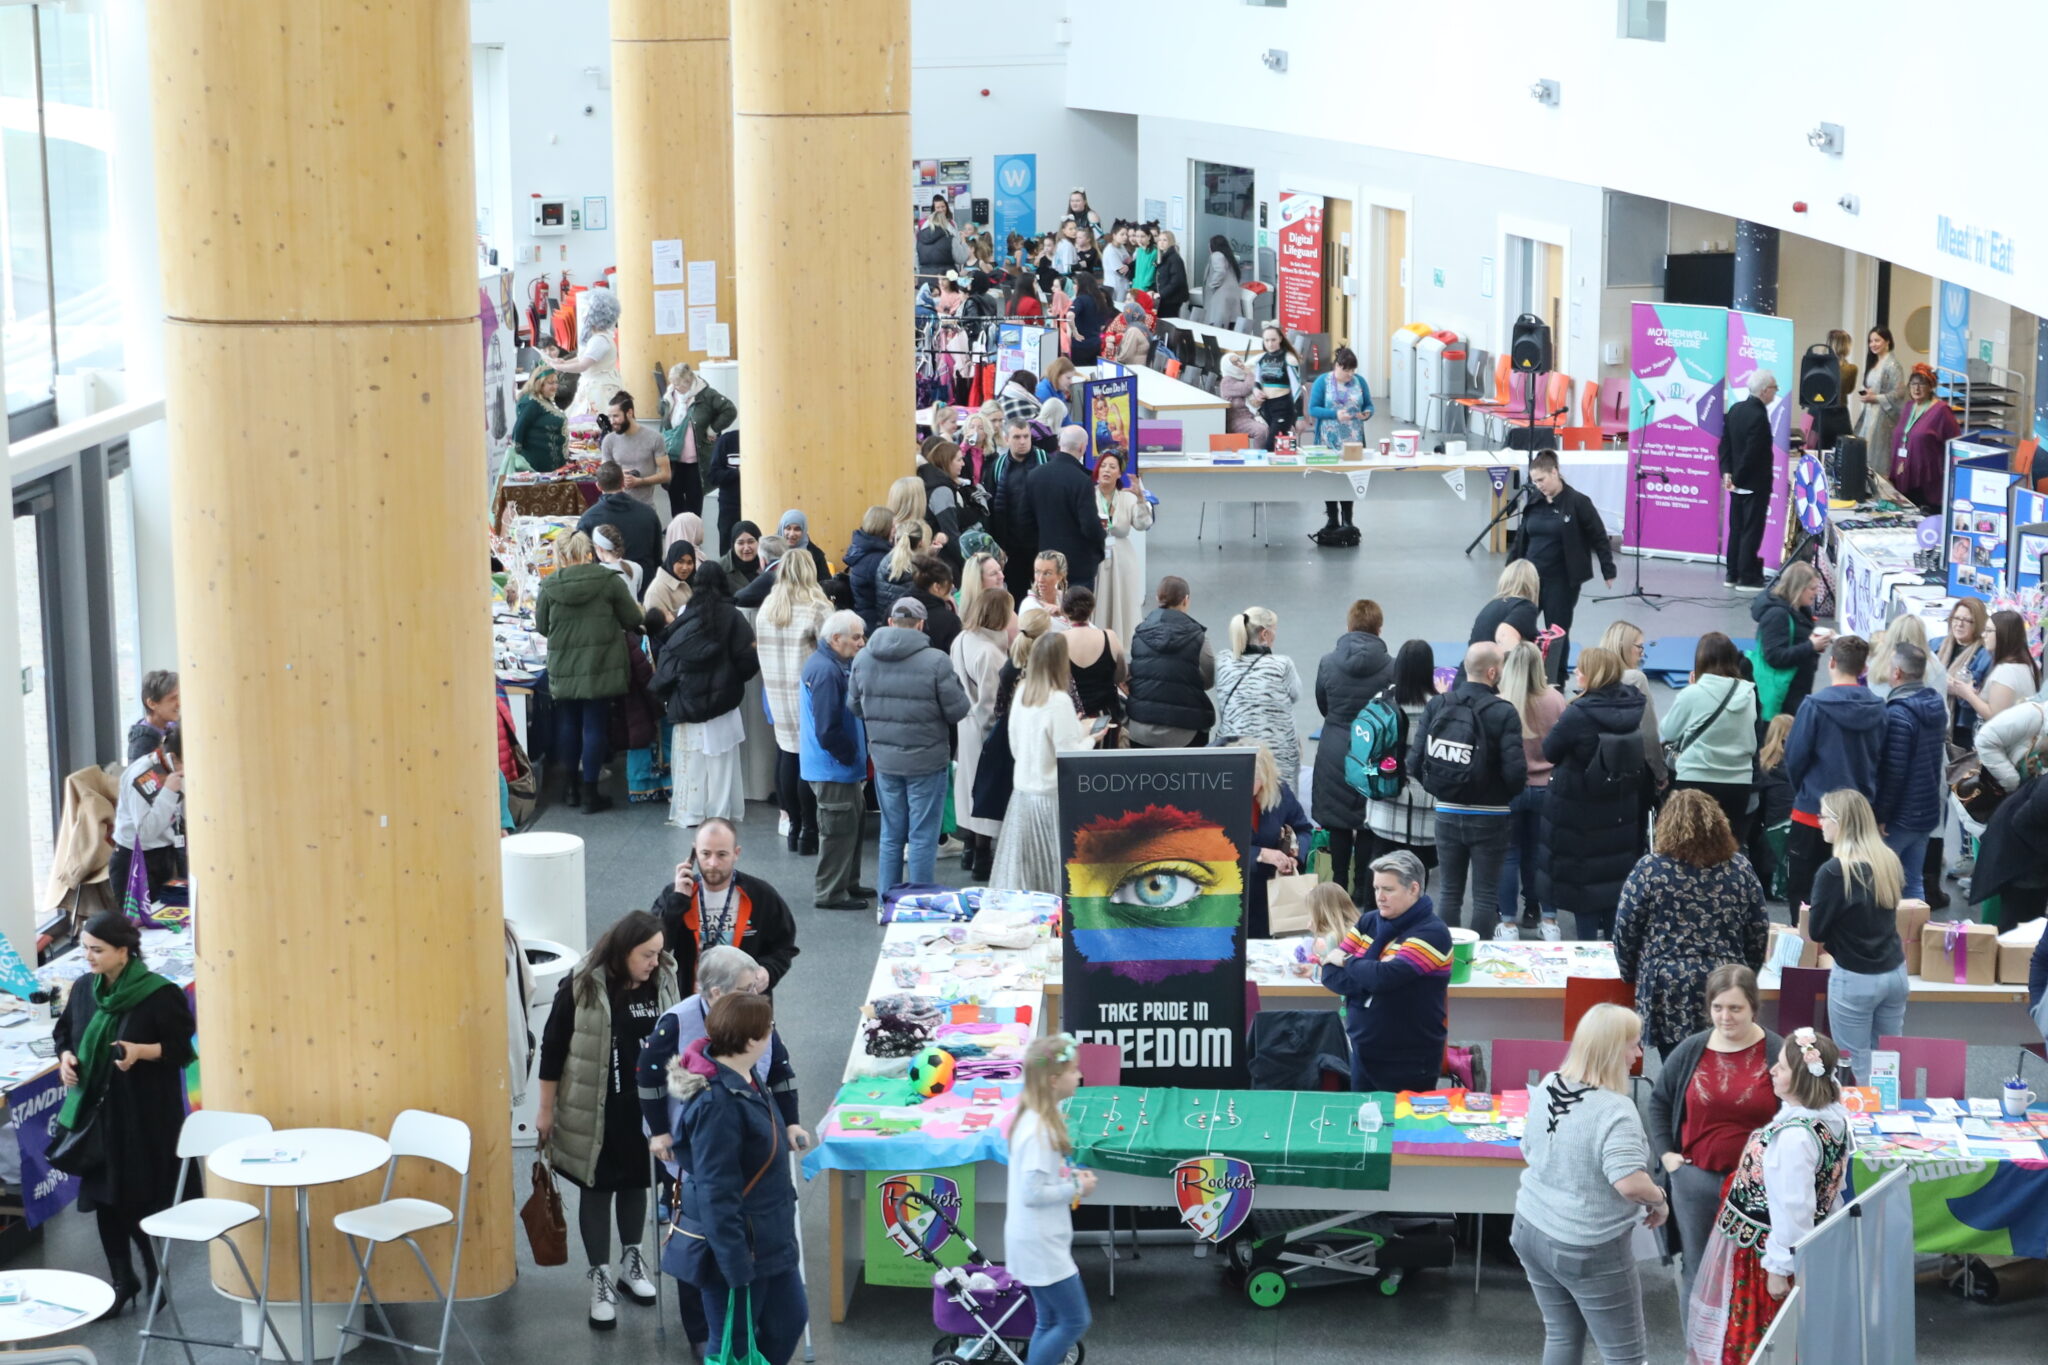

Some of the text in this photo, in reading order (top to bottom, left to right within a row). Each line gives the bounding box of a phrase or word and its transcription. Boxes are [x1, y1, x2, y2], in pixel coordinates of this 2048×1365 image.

[1003, 169, 1026, 188] W
[1288, 232, 1314, 246] Digital
[1937, 214, 1970, 261] Meet
[1990, 230, 2014, 275] Eat
[1283, 244, 1318, 259] Lifeguard
[1647, 328, 1709, 341] MOTHERWELL
[1654, 338, 1702, 350] CHESHIRE
[1742, 335, 1776, 351] INSPIRE
[1738, 347, 1778, 363] CHESHIRE
[1092, 385, 1102, 396] We
[1102, 384, 1113, 394] Can
[1113, 382, 1120, 393] Do
[1427, 734, 1473, 765] VANS
[141, 779, 157, 795] UP
[1078, 772, 1233, 793] BODYPOSITIVE
[701, 923, 737, 932] EACH
[1098, 1001, 1209, 1023] TAKE PRIDE IN
[12, 1085, 69, 1129] STANDI
[1169, 1165, 1257, 1194] Rockets
[877, 1180, 963, 1211] Rokets
